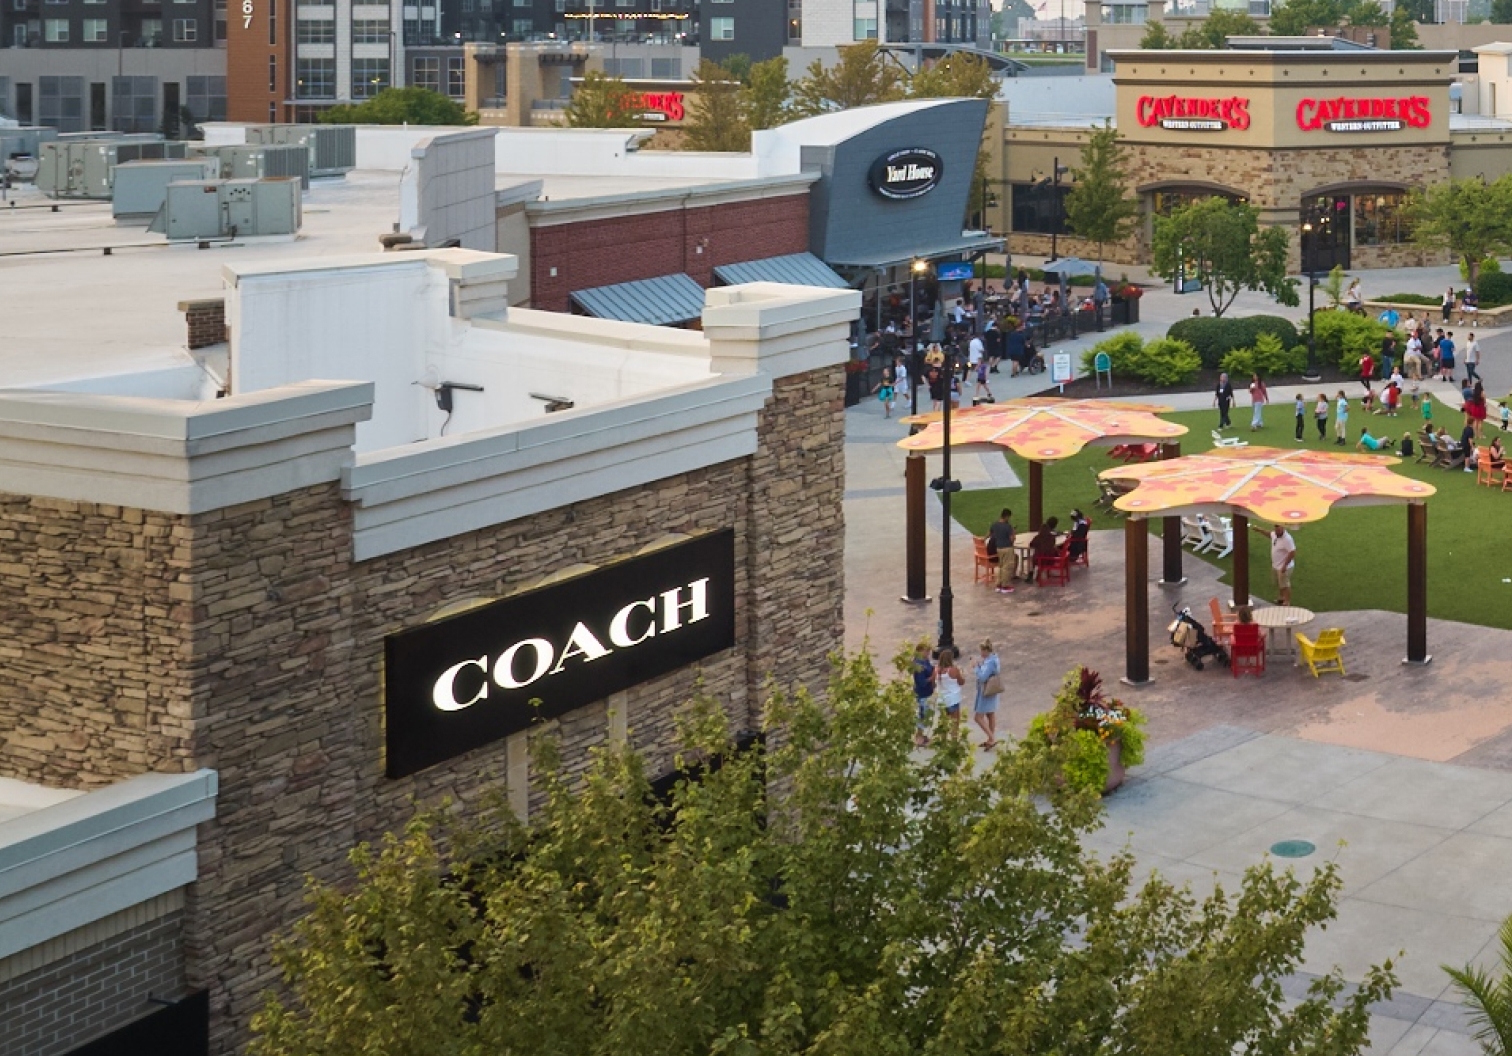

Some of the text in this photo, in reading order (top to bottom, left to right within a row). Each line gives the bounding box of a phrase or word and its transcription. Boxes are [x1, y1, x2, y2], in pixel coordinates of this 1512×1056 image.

[1136, 94, 1250, 130] CAVENDER'S
[1296, 95, 1432, 131] CAVENDER'S
[887, 163, 934, 183] Yard House
[432, 577, 710, 712] COACH
